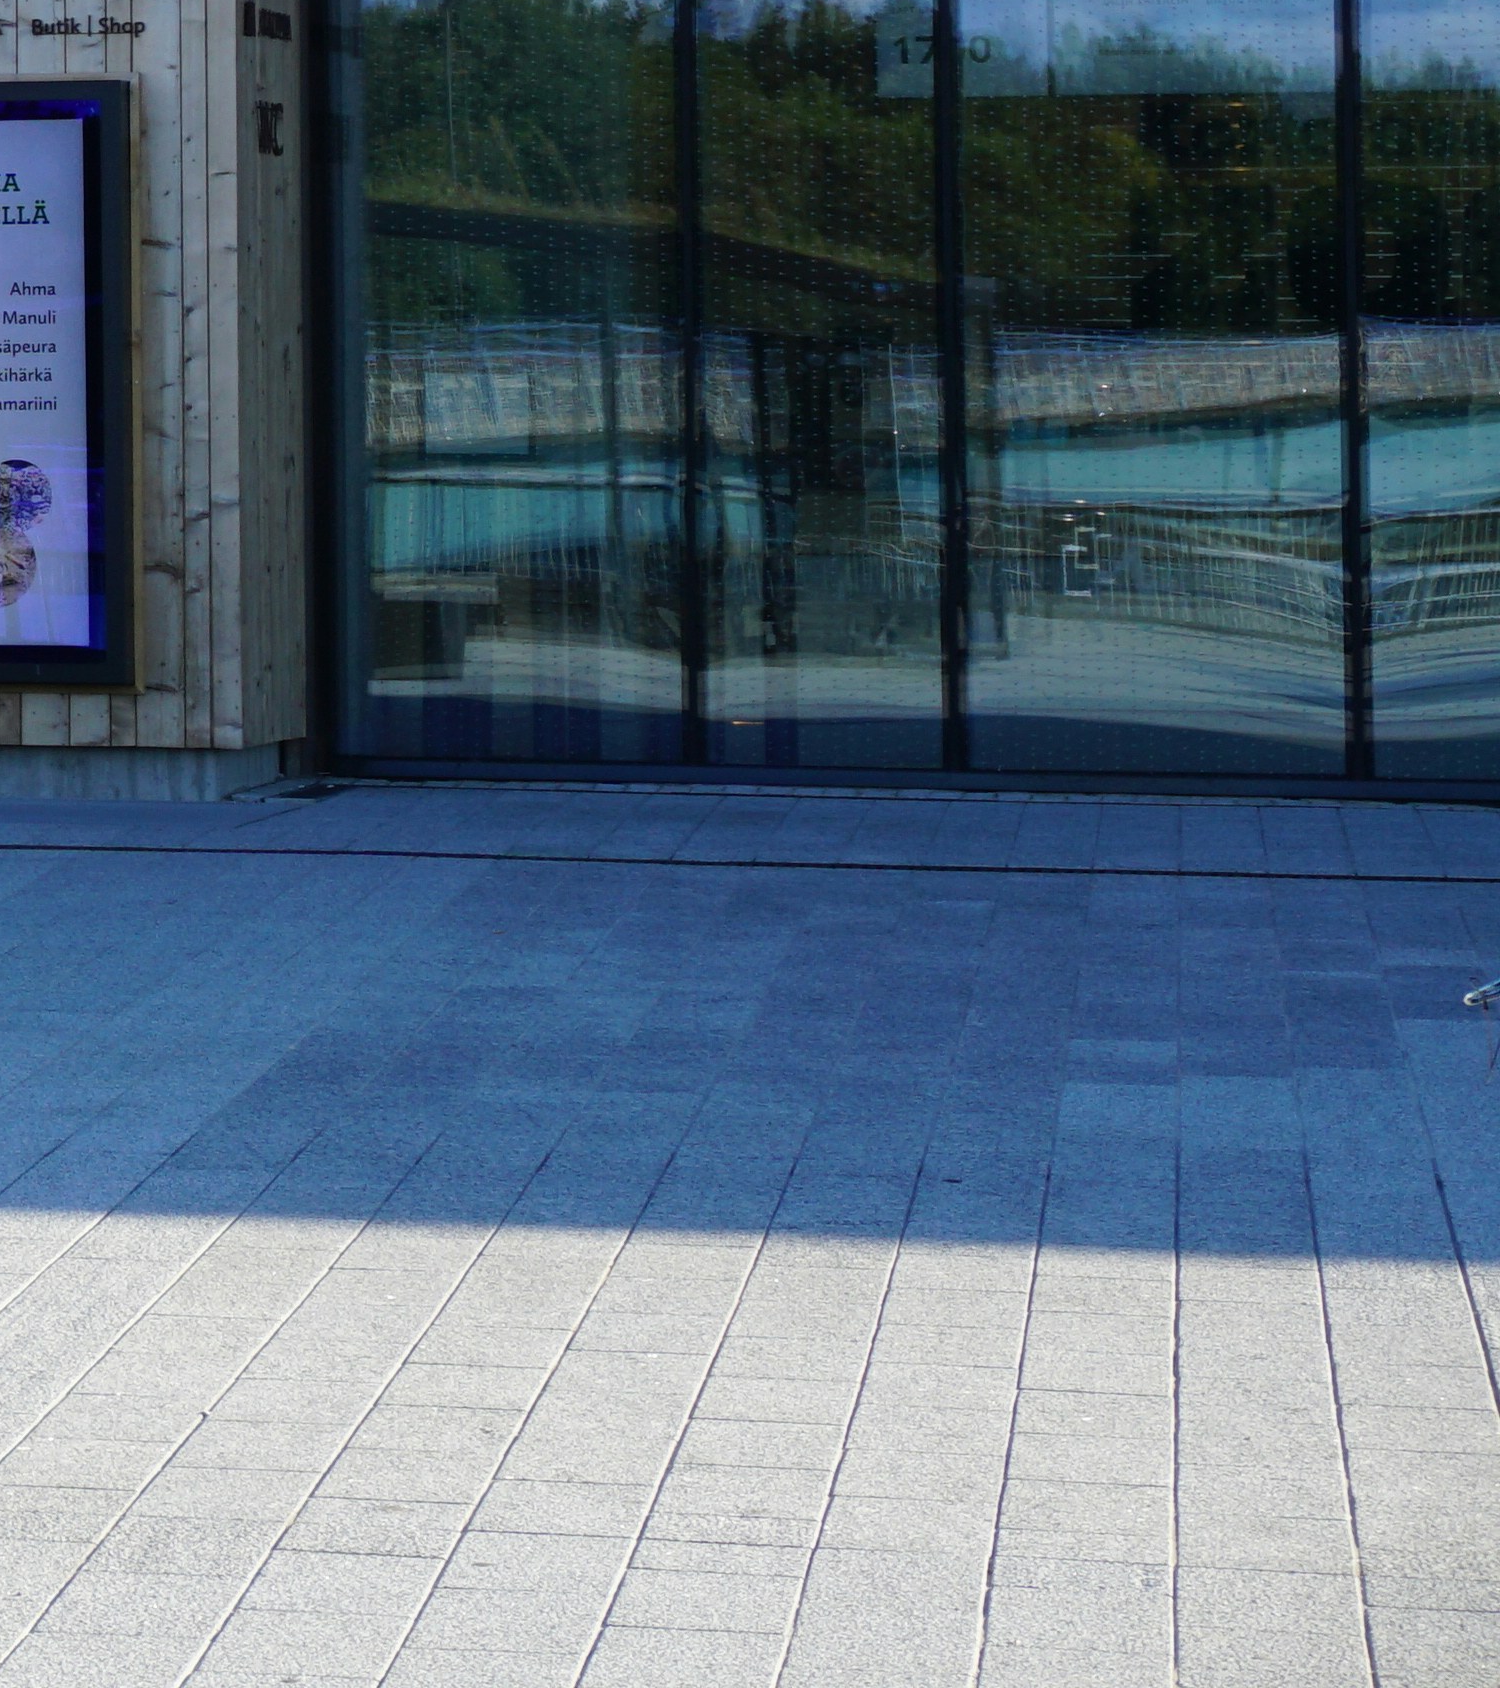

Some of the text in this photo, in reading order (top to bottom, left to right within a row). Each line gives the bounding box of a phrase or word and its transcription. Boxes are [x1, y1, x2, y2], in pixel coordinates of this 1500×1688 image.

[31, 18, 81, 36] Butik
[98, 17, 145, 37] Shop
[10, 282, 56, 295] Ahma
[3, 310, 55, 324] Manuli
